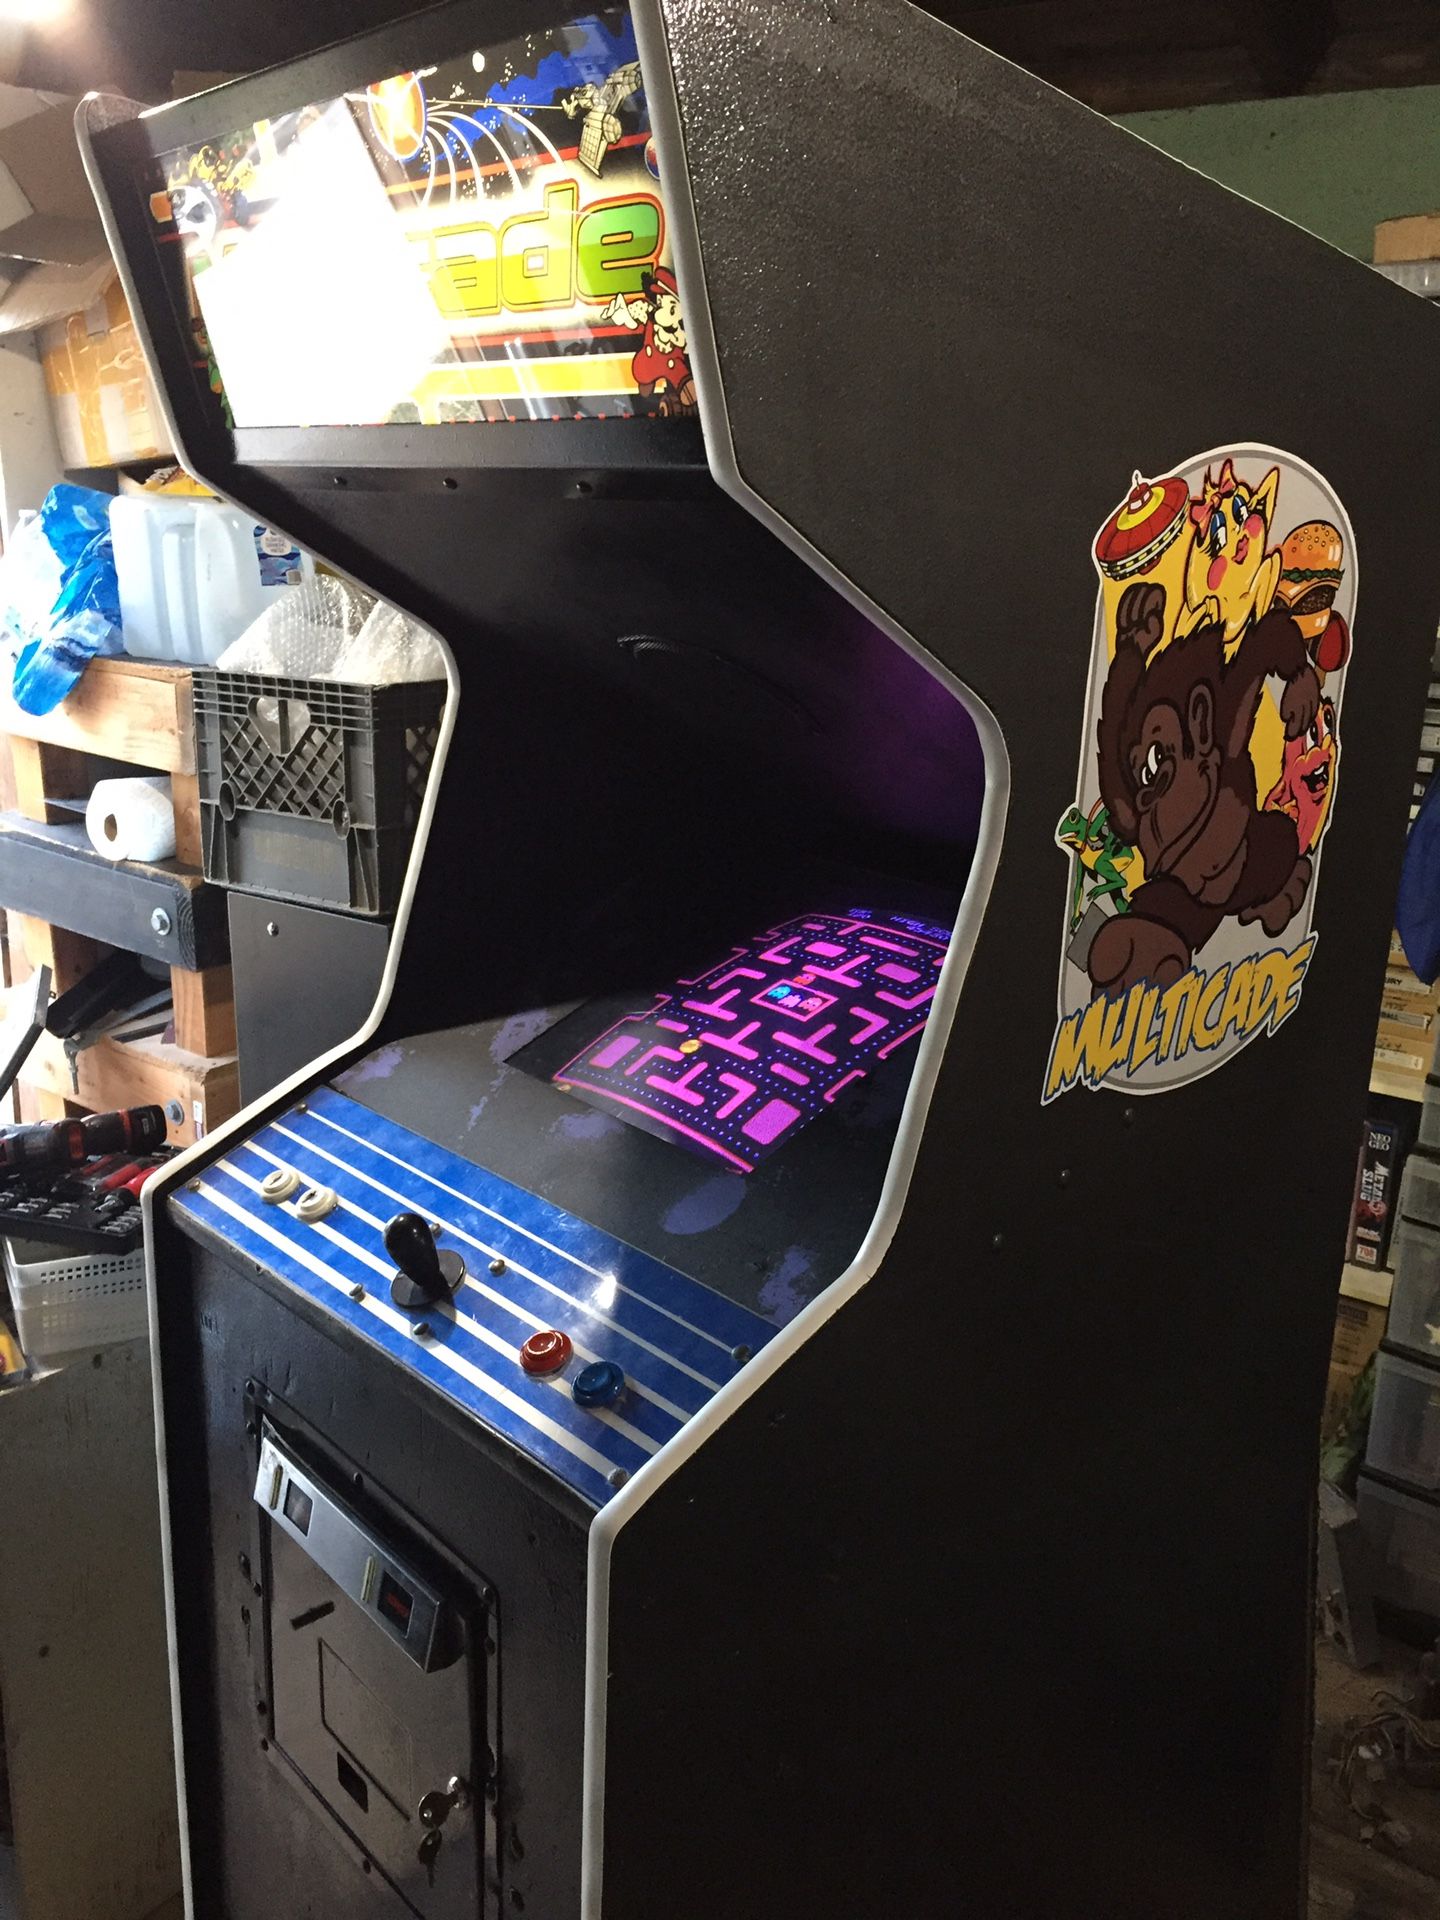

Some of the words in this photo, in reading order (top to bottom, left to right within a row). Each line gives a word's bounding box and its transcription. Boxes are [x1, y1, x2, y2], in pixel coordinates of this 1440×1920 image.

[420, 178, 666, 321] ade
[1043, 935, 1316, 1101] MULTICADE
[1368, 1140, 1390, 1151] GEO
[1369, 1131, 1391, 1145] NEO
[1360, 1168, 1374, 1202] SLUG
